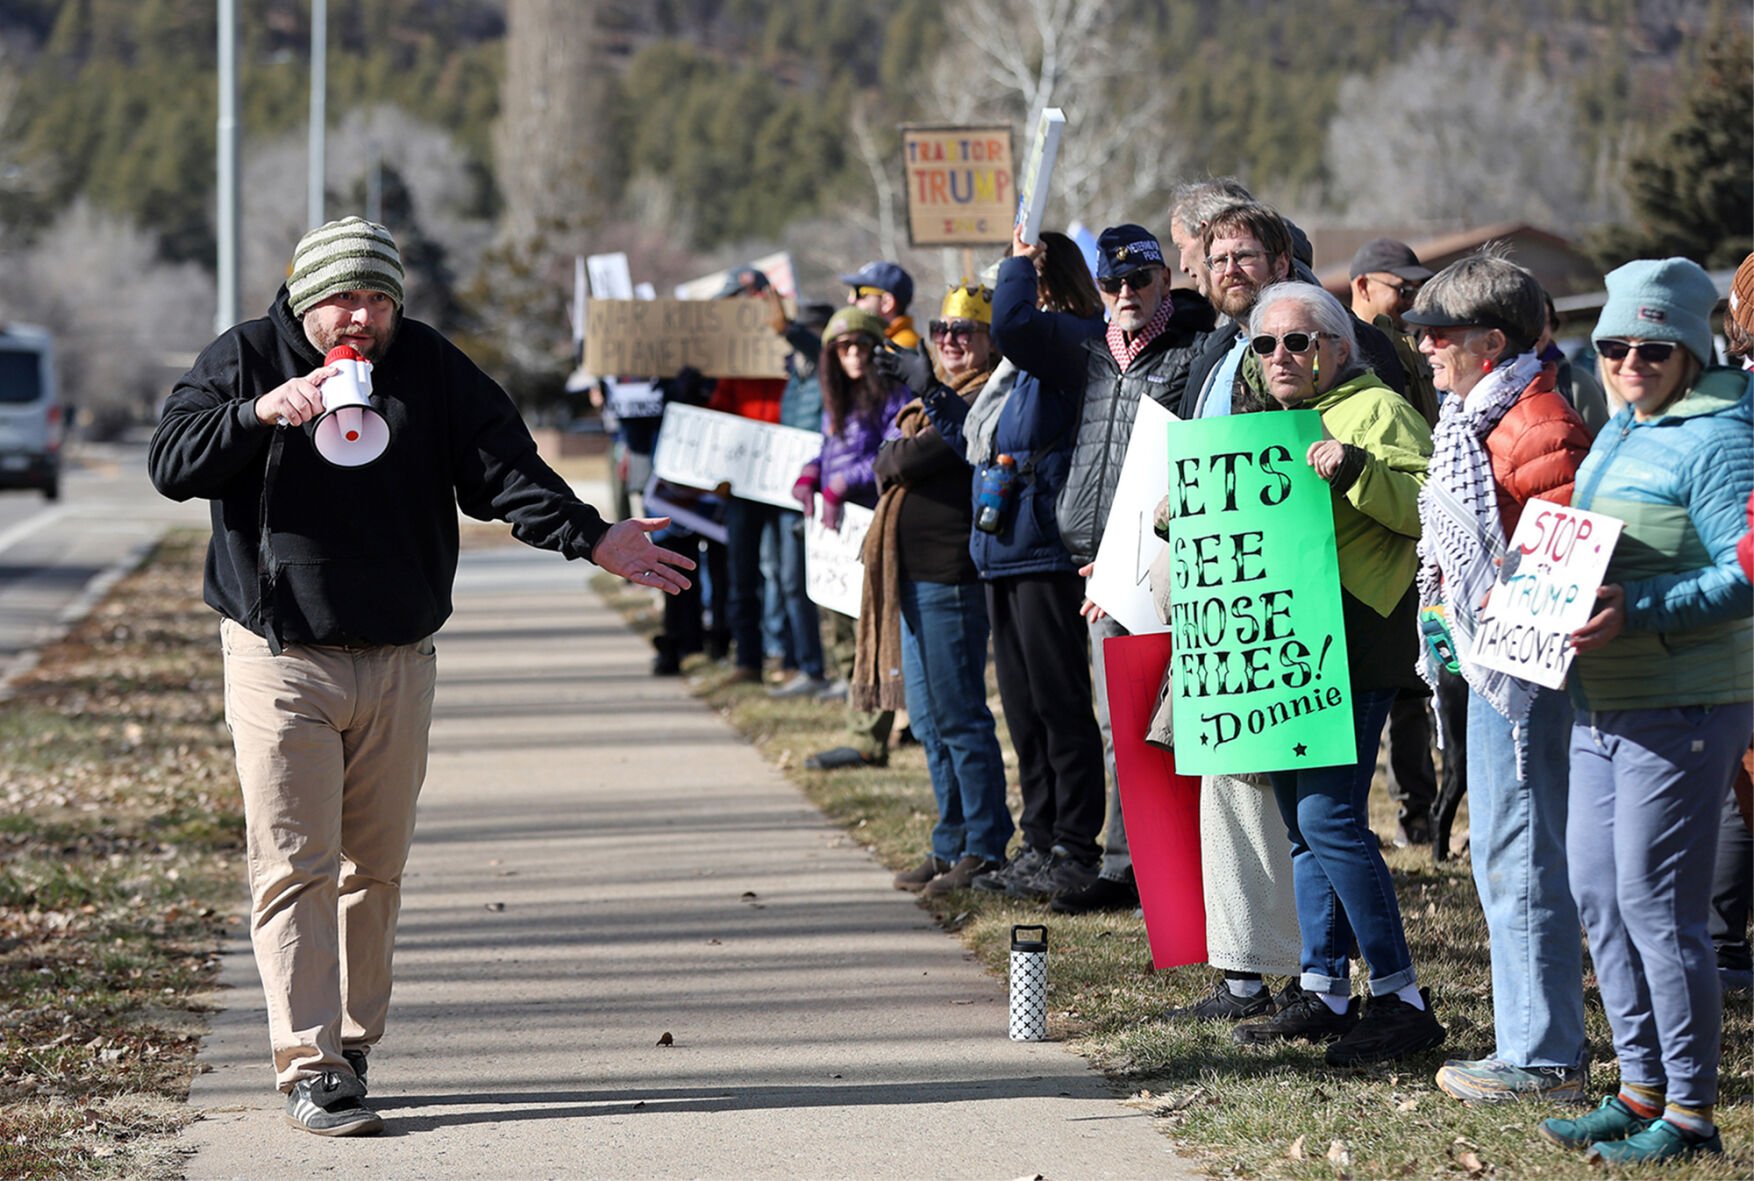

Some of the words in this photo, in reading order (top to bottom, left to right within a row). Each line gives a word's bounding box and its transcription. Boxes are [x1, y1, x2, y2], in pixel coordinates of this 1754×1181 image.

[908, 140, 1002, 162] TRAITOR
[913, 168, 1009, 204] TRUMP
[1169, 445, 1293, 521] ETS
[1175, 531, 1267, 590] SEE
[1172, 590, 1296, 650] THOSE
[1507, 574, 1580, 617] TRUMP
[1180, 635, 1333, 698] FILES!
[1477, 616, 1576, 673] TAKEOVER
[1201, 686, 1342, 753] Donnie
